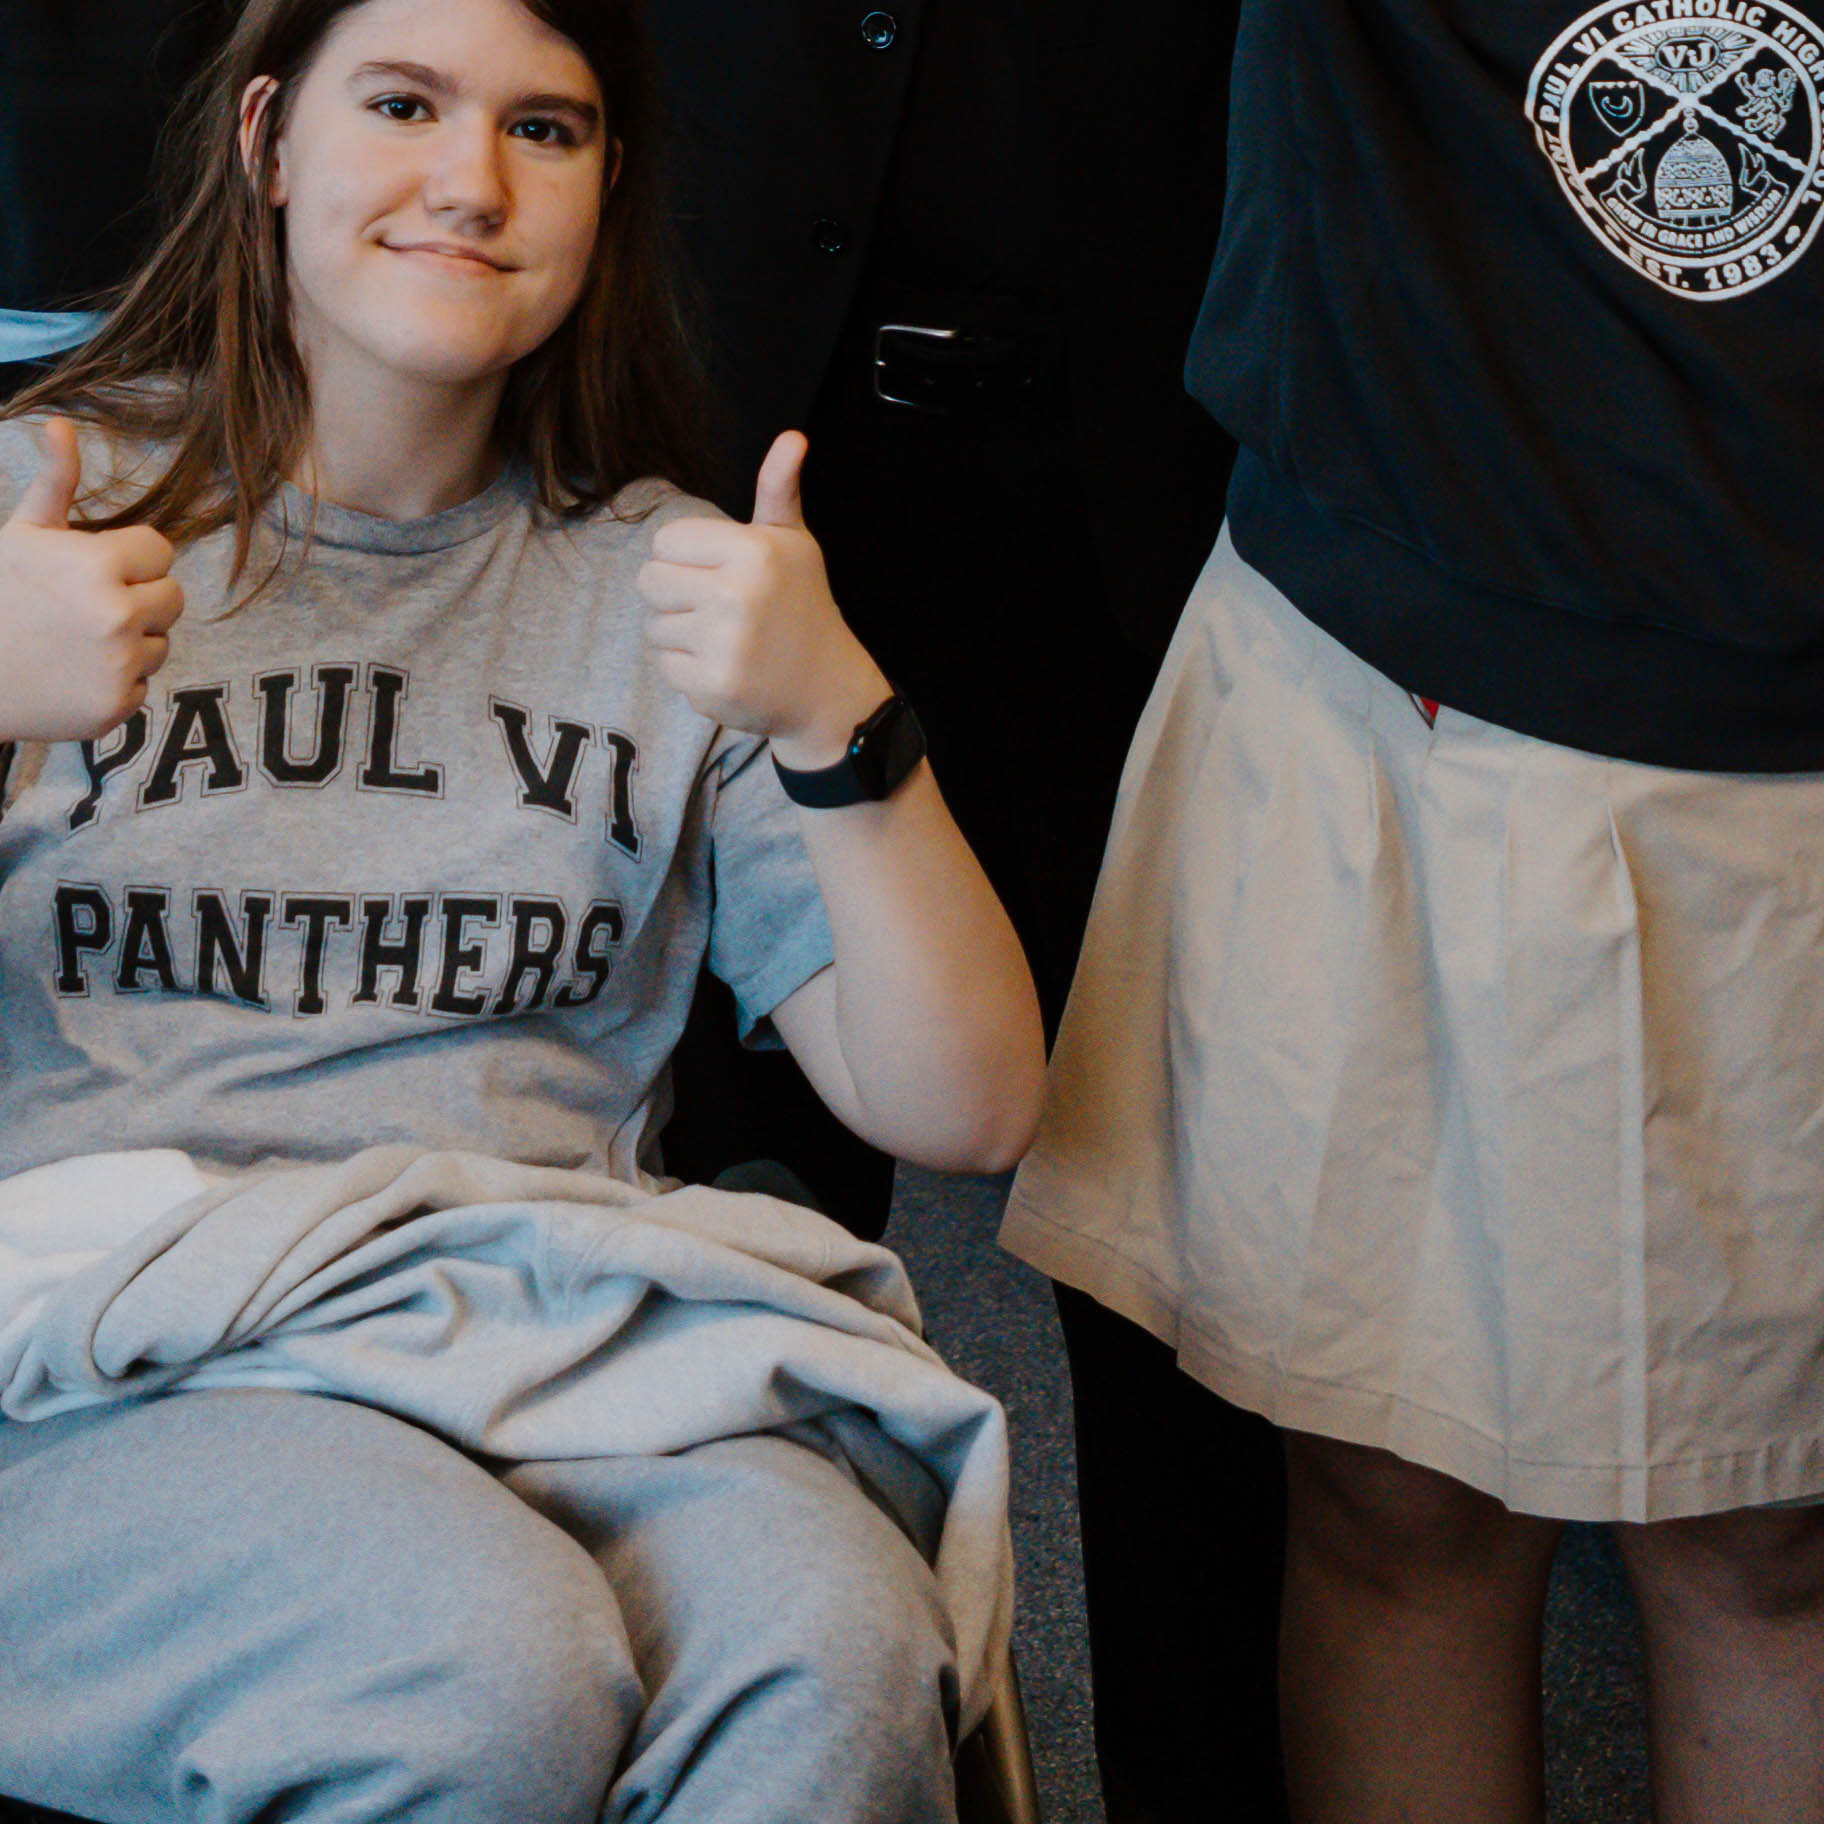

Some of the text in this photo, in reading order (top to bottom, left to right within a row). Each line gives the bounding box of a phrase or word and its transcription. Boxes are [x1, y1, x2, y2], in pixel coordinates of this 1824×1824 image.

[1539, 61, 1580, 124] PAUL
[1573, 26, 1608, 56] VI
[1640, 222, 1658, 239] IN
[1658, 229, 1703, 249] GRACE
[1705, 226, 1735, 247] AND
[1733, 179, 1783, 235] WISDOM
[1628, 243, 1782, 290] EST. 1983
[64, 662, 644, 862] PAUL VI
[52, 879, 627, 1020] PANTHERS
